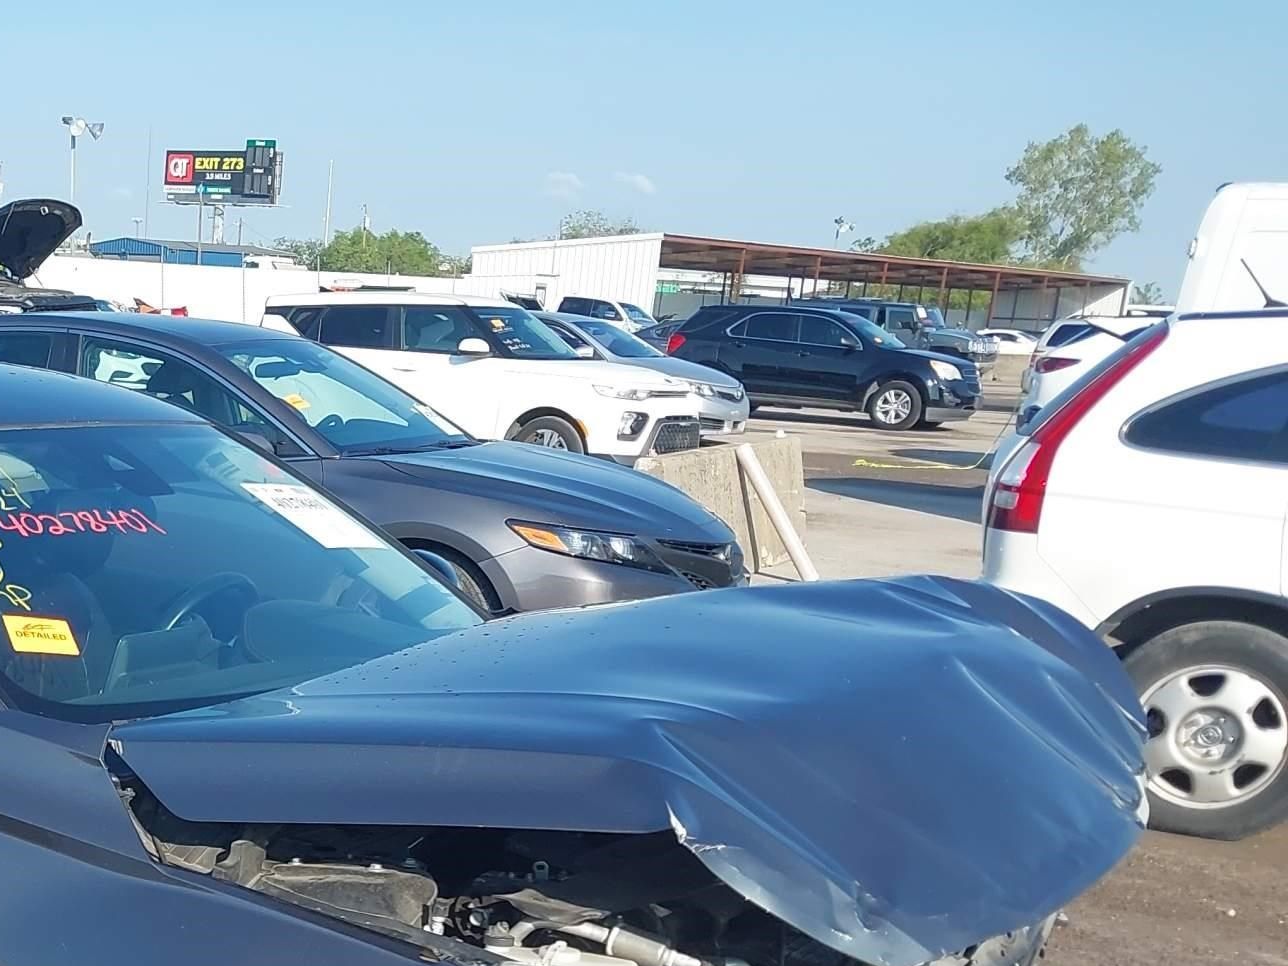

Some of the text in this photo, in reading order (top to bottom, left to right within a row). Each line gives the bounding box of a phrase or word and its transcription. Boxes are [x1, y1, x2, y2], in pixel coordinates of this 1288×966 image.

[195, 157, 244, 169] EXIT 273
[15, 630, 67, 641] DETAILED
